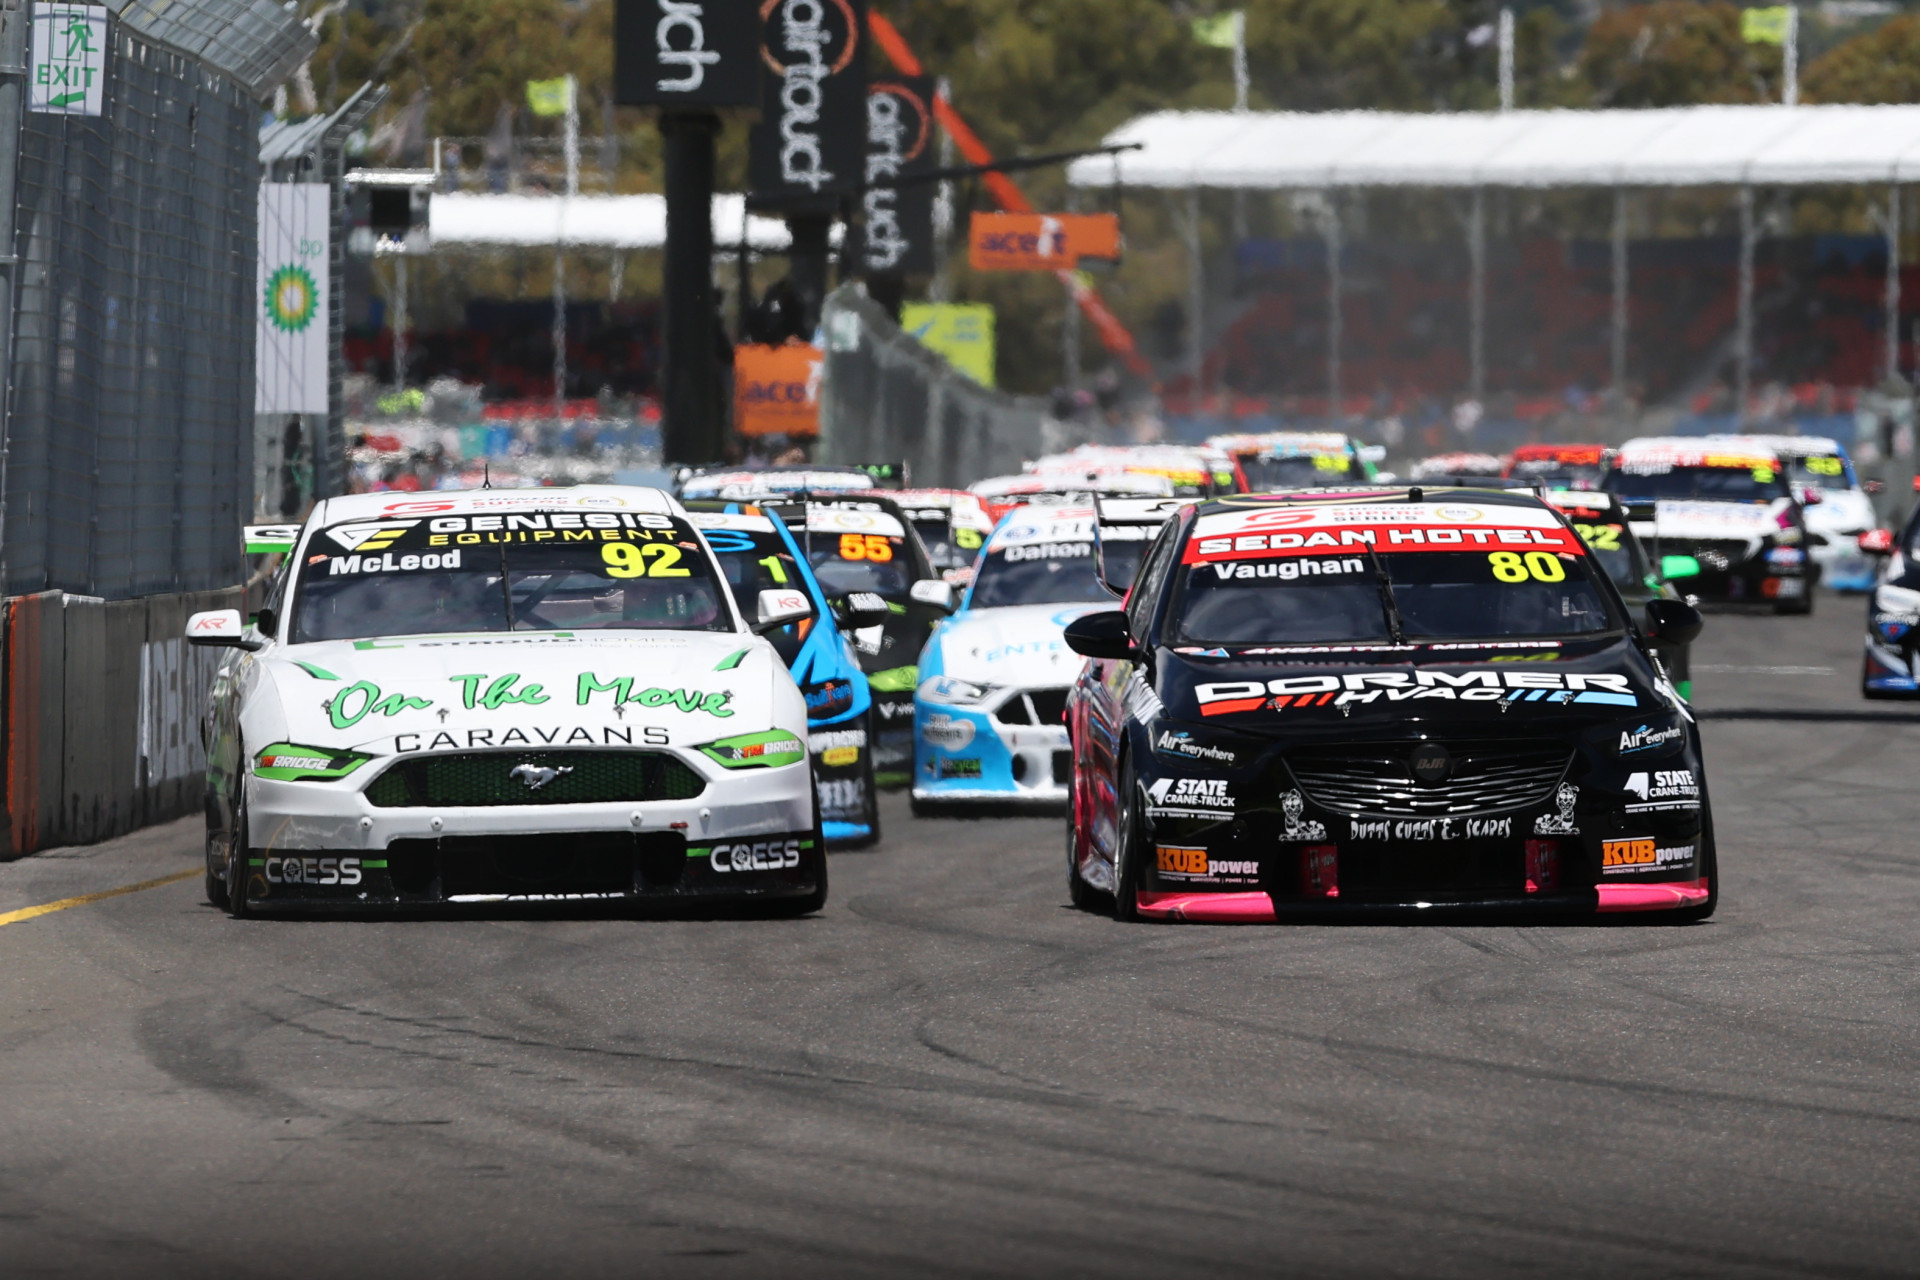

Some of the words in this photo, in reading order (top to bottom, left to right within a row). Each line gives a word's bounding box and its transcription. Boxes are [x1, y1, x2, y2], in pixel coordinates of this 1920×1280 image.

[37, 64, 98, 88] EXIT
[300, 235, 323, 260] bp
[429, 513, 674, 533] GENESIS
[429, 529, 677, 546] EQUIPMENT
[839, 533, 893, 563] 55
[1199, 530, 1376, 554] SEDAN
[1387, 529, 1564, 545] HOTEL
[329, 549, 461, 575] McLeod
[601, 542, 691, 578] 92
[1004, 541, 1091, 562] Dalton
[759, 555, 788, 583] 1
[1213, 558, 1364, 580] Vaughan
[1488, 551, 1566, 583] 80
[777, 597, 802, 608] KR
[194, 618, 227, 630] KR
[1429, 641, 1562, 650] MOTORS
[1195, 671, 1634, 704] DORMER
[1334, 687, 1505, 705] HVAC
[329, 680, 433, 729] On
[449, 673, 551, 710] The
[577, 672, 735, 718] Move
[395, 726, 669, 752] CARAVANS
[1157, 730, 1179, 750] Air
[1180, 743, 1235, 762] everywhere
[1619, 731, 1642, 750] Air
[1646, 726, 1681, 744] everywhere
[1416, 757, 1446, 770] BJR
[1175, 778, 1228, 797] STATE
[1655, 770, 1694, 787] STATE
[1350, 820, 1390, 841] DUTTS
[1465, 817, 1512, 839] SCAPES
